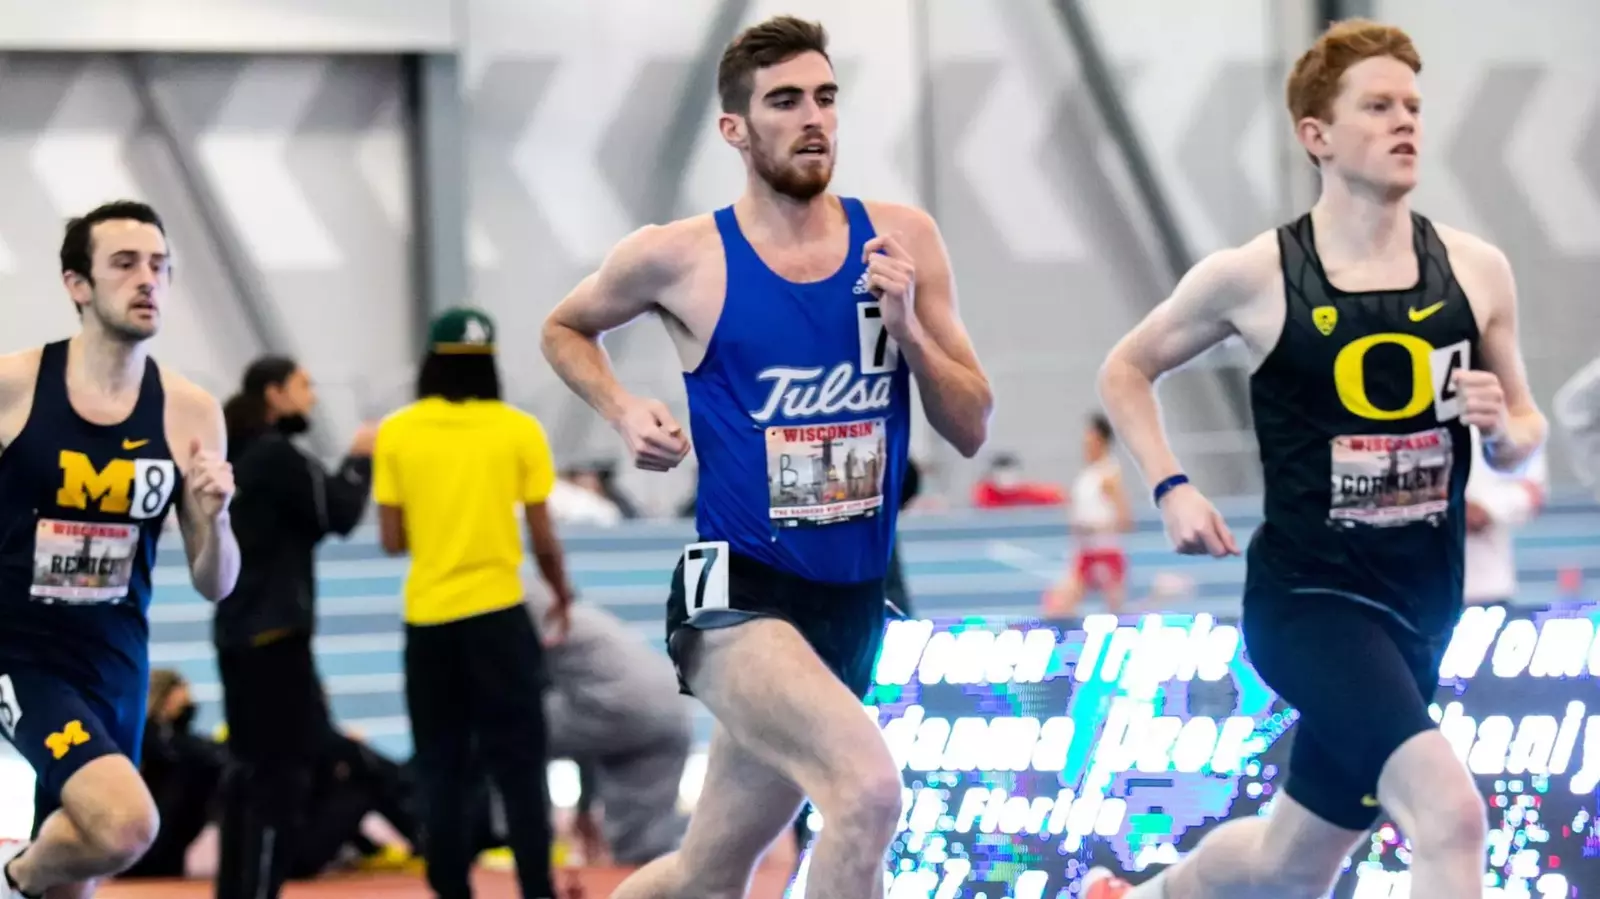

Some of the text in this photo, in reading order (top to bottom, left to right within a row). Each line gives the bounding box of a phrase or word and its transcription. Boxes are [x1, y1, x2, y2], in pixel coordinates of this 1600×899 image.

[864, 305, 888, 368] 7
[751, 363, 890, 421] Tulsa
[1333, 332, 1434, 421] O
[783, 421, 873, 443] WISCONSIN
[56, 449, 135, 513] M
[142, 464, 164, 514] 8
[687, 547, 719, 609] 7
[45, 720, 91, 760] M
